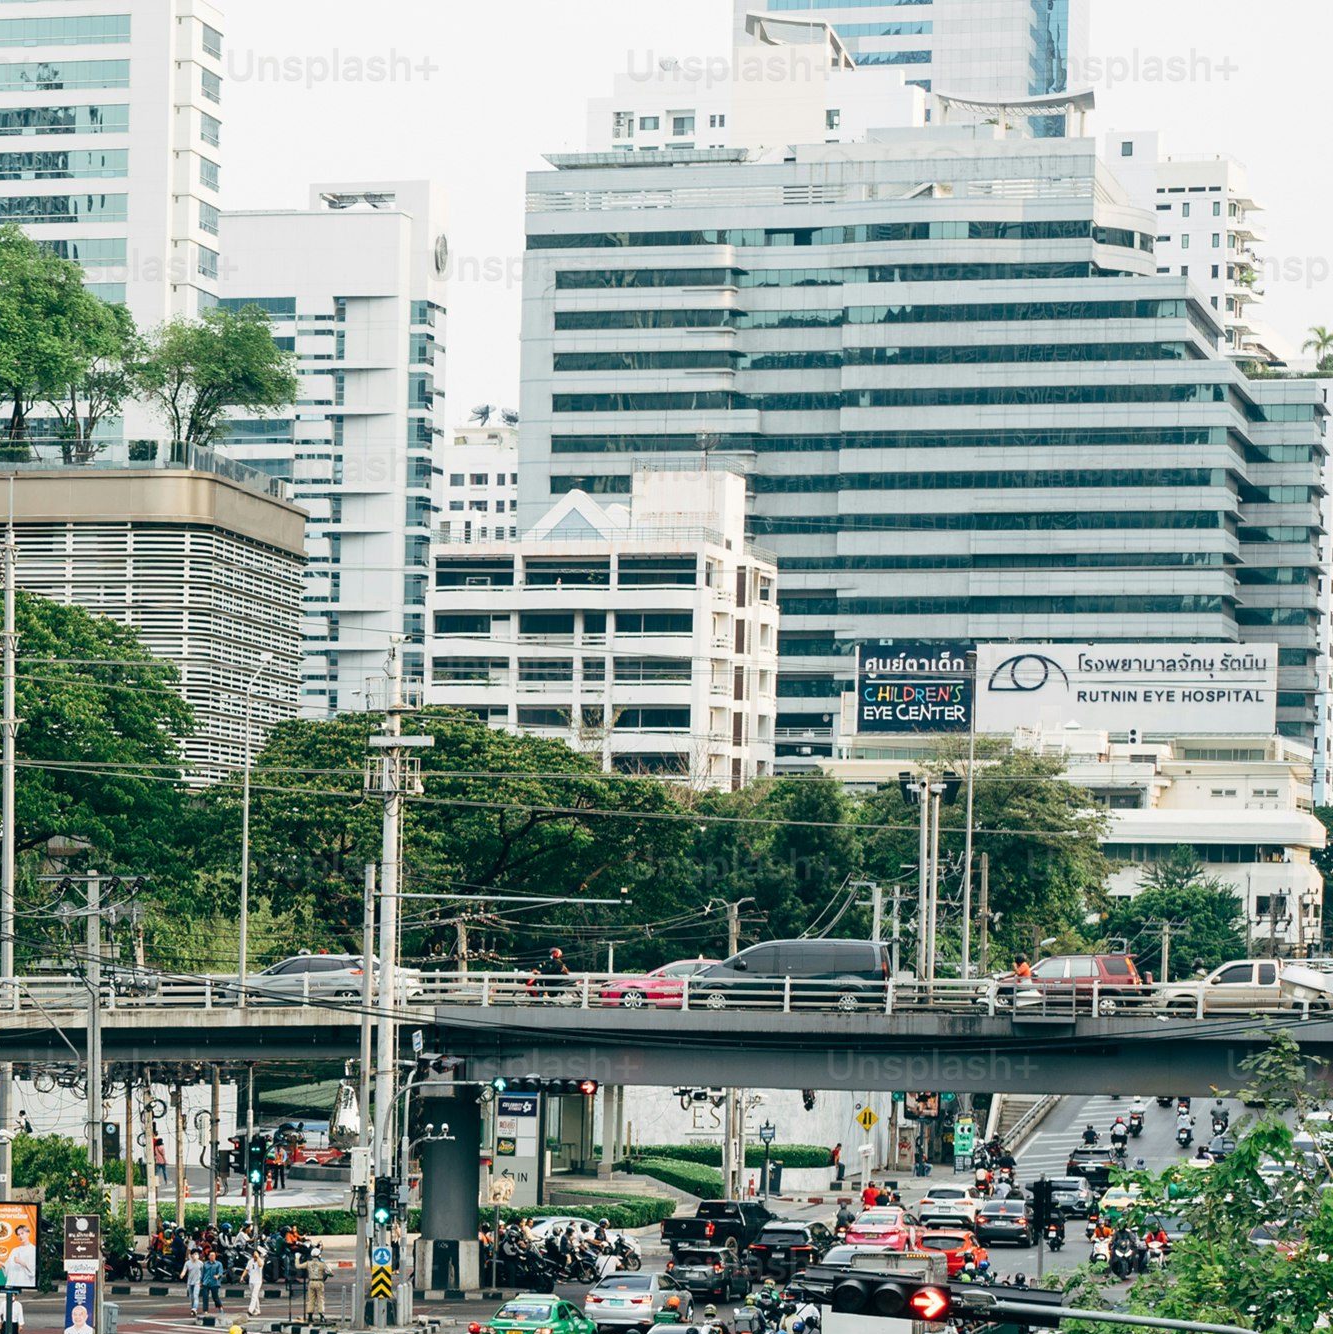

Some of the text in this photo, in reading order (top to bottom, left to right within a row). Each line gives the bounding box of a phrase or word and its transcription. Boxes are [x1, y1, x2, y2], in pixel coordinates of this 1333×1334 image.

[865, 652, 965, 678] ศูนย์ตาเด็ก
[1078, 653, 1267, 679] โรงพยาบาลจักษุ รัตนิน
[864, 685, 965, 704] CHILDREN'S
[1077, 690, 1264, 703] RUTNIN EYE HOSPITAL
[863, 704, 966, 722] EYE CENTER
[693, 1105, 755, 1129] ESE
[517, 1172, 528, 1183] IN
